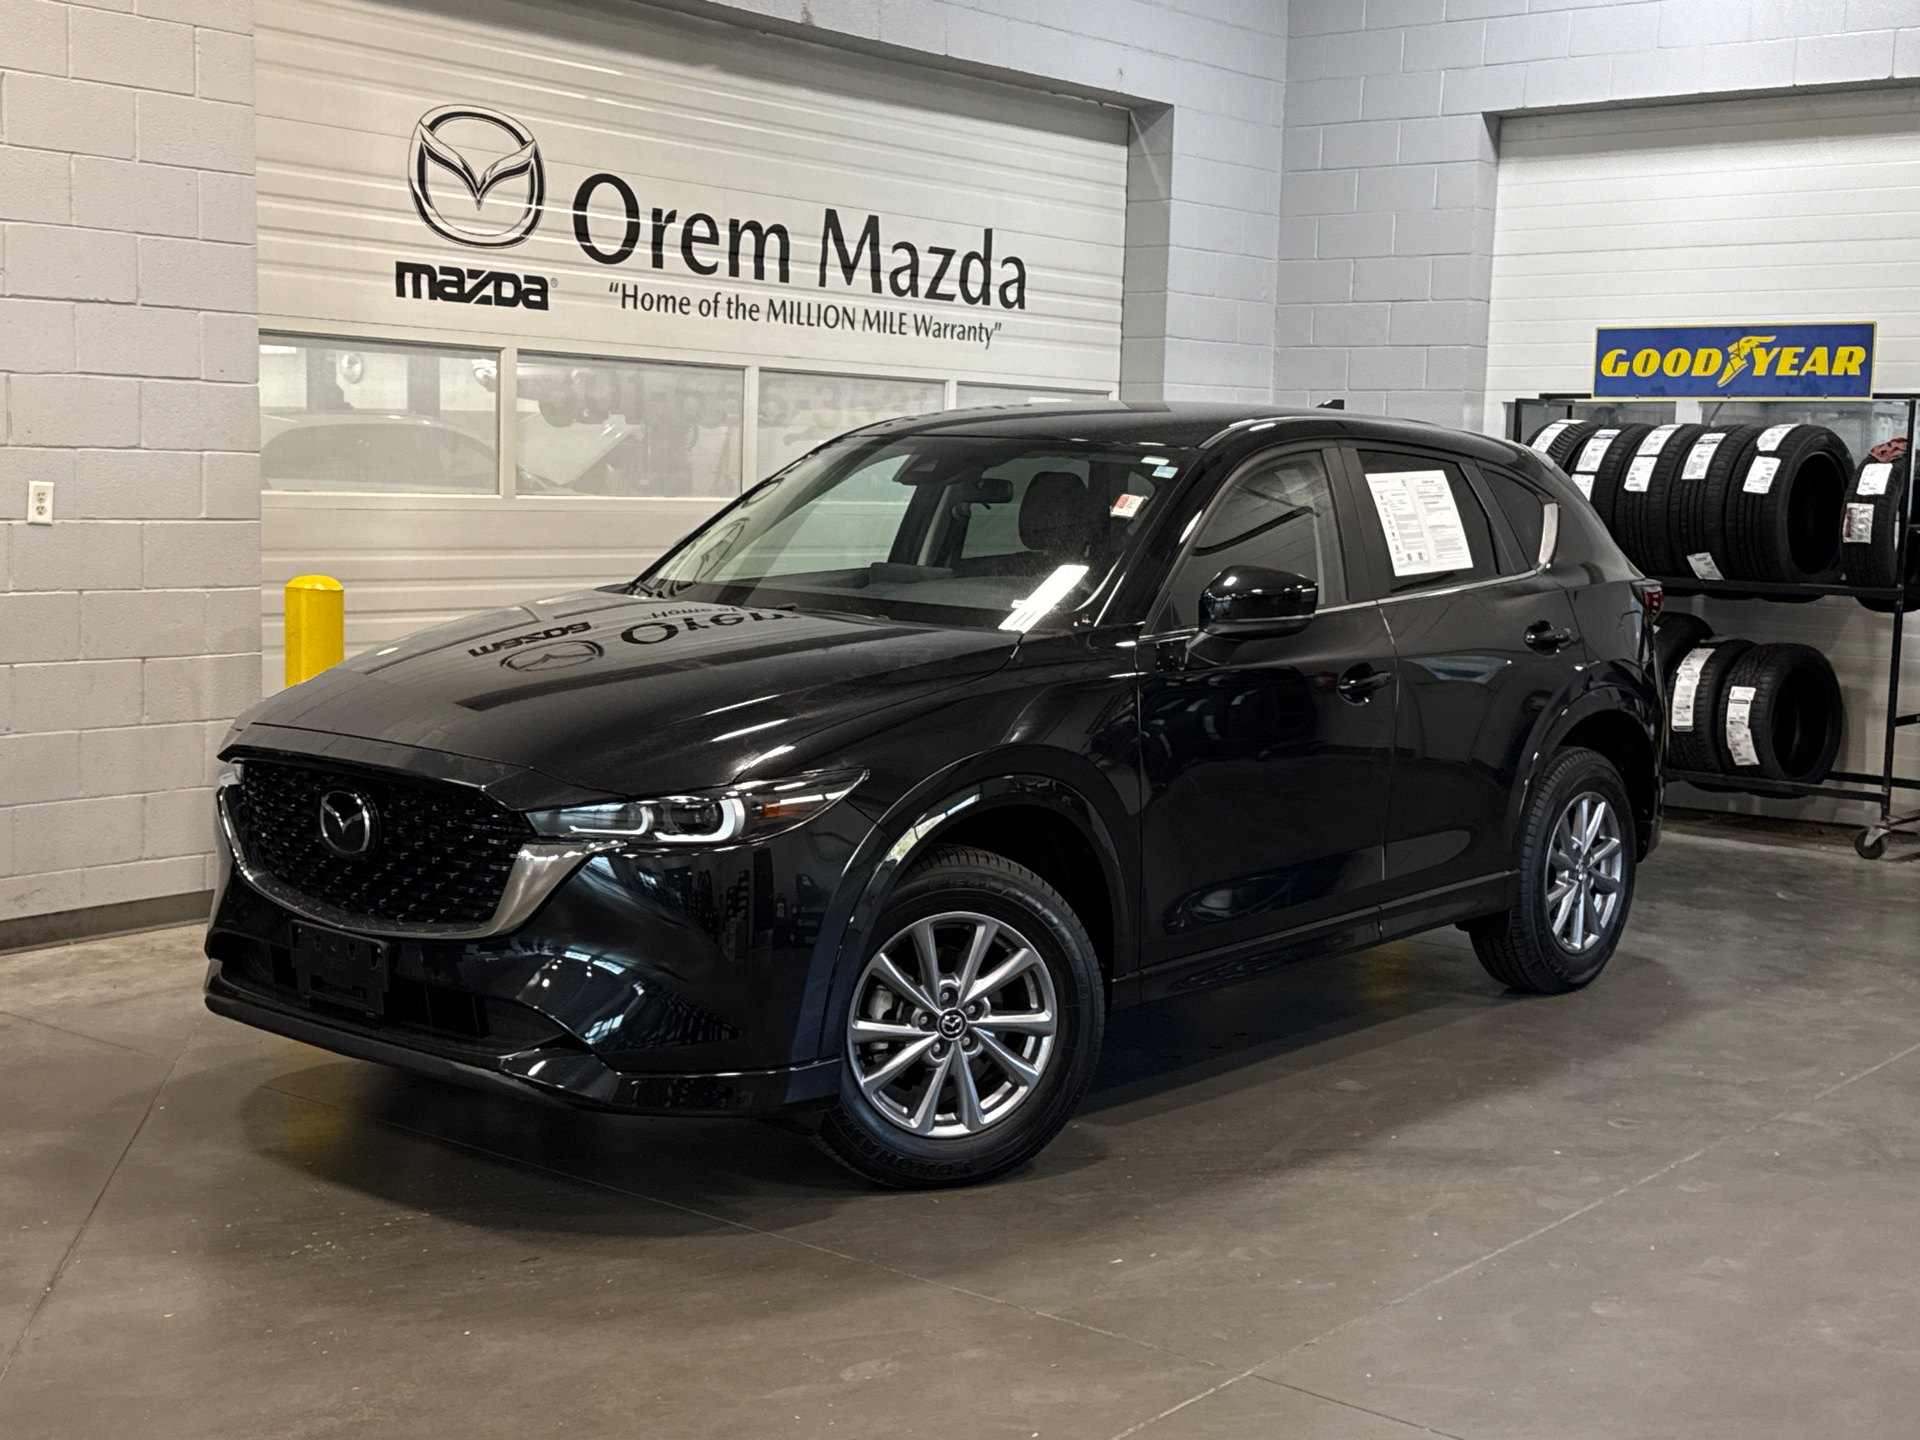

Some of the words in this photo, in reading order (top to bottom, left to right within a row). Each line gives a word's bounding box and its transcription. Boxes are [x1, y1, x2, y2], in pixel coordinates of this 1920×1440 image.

[572, 173, 790, 284] Orem
[818, 207, 1027, 311] Mazda
[698, 292, 722, 319] of
[726, 294, 760, 322] the
[766, 298, 857, 331] MILLION
[862, 308, 908, 336] MILE
